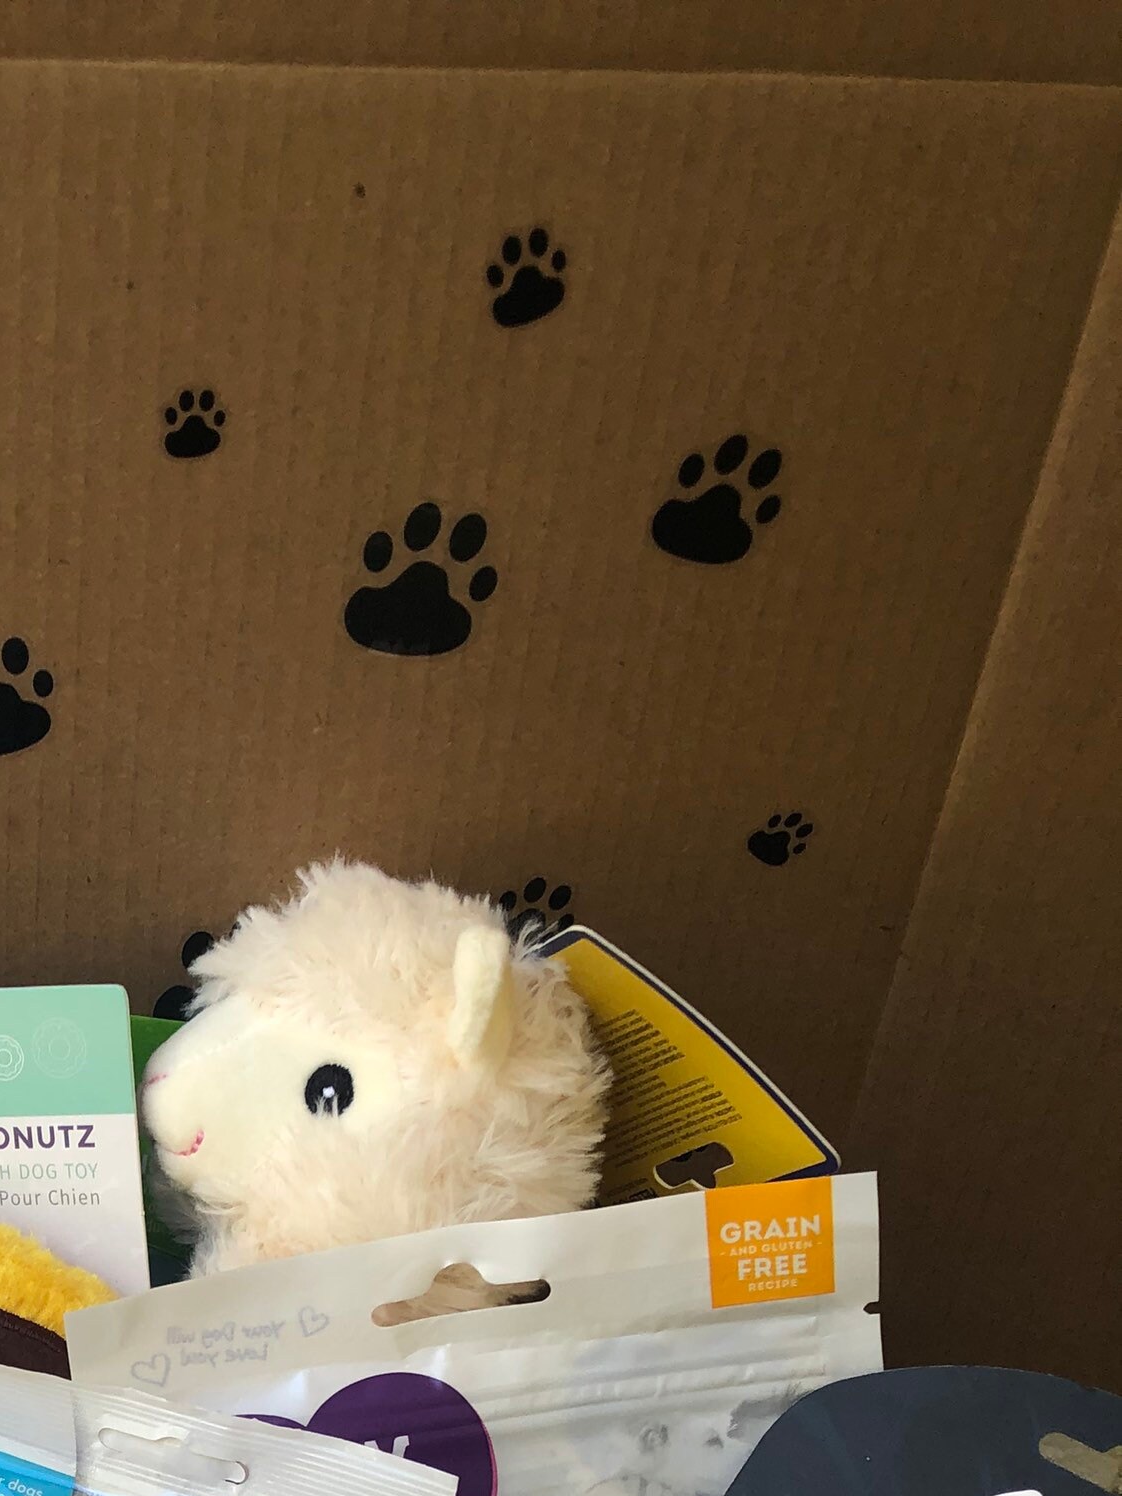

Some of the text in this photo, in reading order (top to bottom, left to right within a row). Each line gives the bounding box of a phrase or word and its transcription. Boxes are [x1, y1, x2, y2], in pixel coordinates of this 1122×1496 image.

[19, 1163, 57, 1180] DOG
[65, 1162, 99, 1179] TOY
[0, 1189, 41, 1207] Pour
[48, 1187, 101, 1206] Chien
[720, 1214, 821, 1244] GRAIN
[729, 1239, 814, 1257] AND GLUTEN
[737, 1253, 808, 1281] FREE
[747, 1278, 799, 1292] RECIPE
